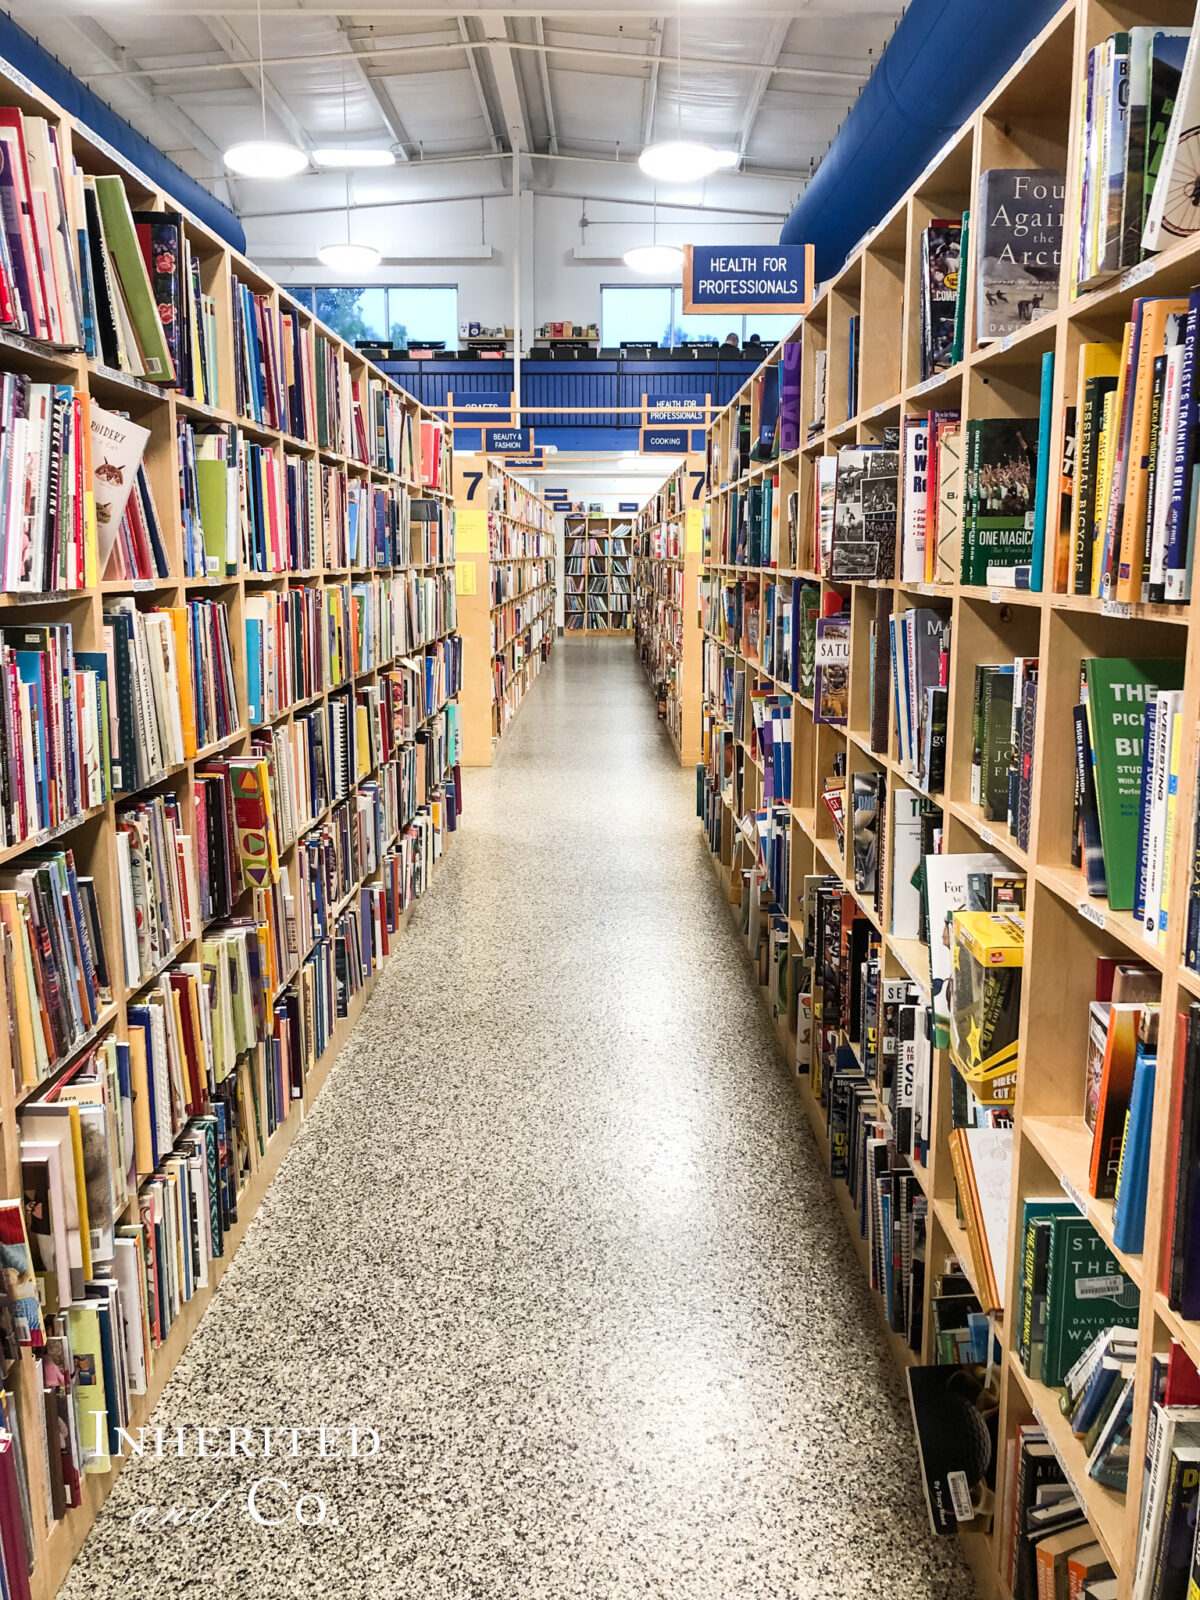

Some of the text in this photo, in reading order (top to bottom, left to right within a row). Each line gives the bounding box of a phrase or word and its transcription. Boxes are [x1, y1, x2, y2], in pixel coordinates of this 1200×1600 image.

[1033, 231, 1054, 243] the
[710, 257, 787, 272] HEALTH FOR
[698, 279, 799, 294] PROFESSIONALS
[1185, 308, 1197, 333] THE
[1180, 335, 1195, 401] CYCLIST'S
[650, 411, 703, 420] PROFESSIONALS
[493, 433, 522, 441] BEAUTY &
[650, 437, 681, 445] COOKING
[1175, 403, 1189, 463] TRAINING
[494, 441, 521, 449] FASHION
[463, 472, 483, 501] 7
[689, 471, 706, 500] 7
[1075, 401, 1093, 572] ESSENTIAL BICYCLE
[1172, 466, 1185, 502] BIBLE
[979, 530, 999, 546] ONE
[1109, 683, 1159, 702] THE
[1075, 720, 1083, 745] INSIDE
[1157, 701, 1168, 801] EVERESTING
[1078, 752, 1086, 793] MARATHON
[1117, 777, 1135, 785] With
[943, 881, 965, 894] For
[992, 1088, 1009, 1100] CUT
[1026, 1250, 1035, 1290] FUTURE
[1025, 1291, 1032, 1305] OF
[1023, 1308, 1031, 1346] TENNIS
[1036, 1465, 1043, 1478] A
[934, 1480, 940, 1489] By
